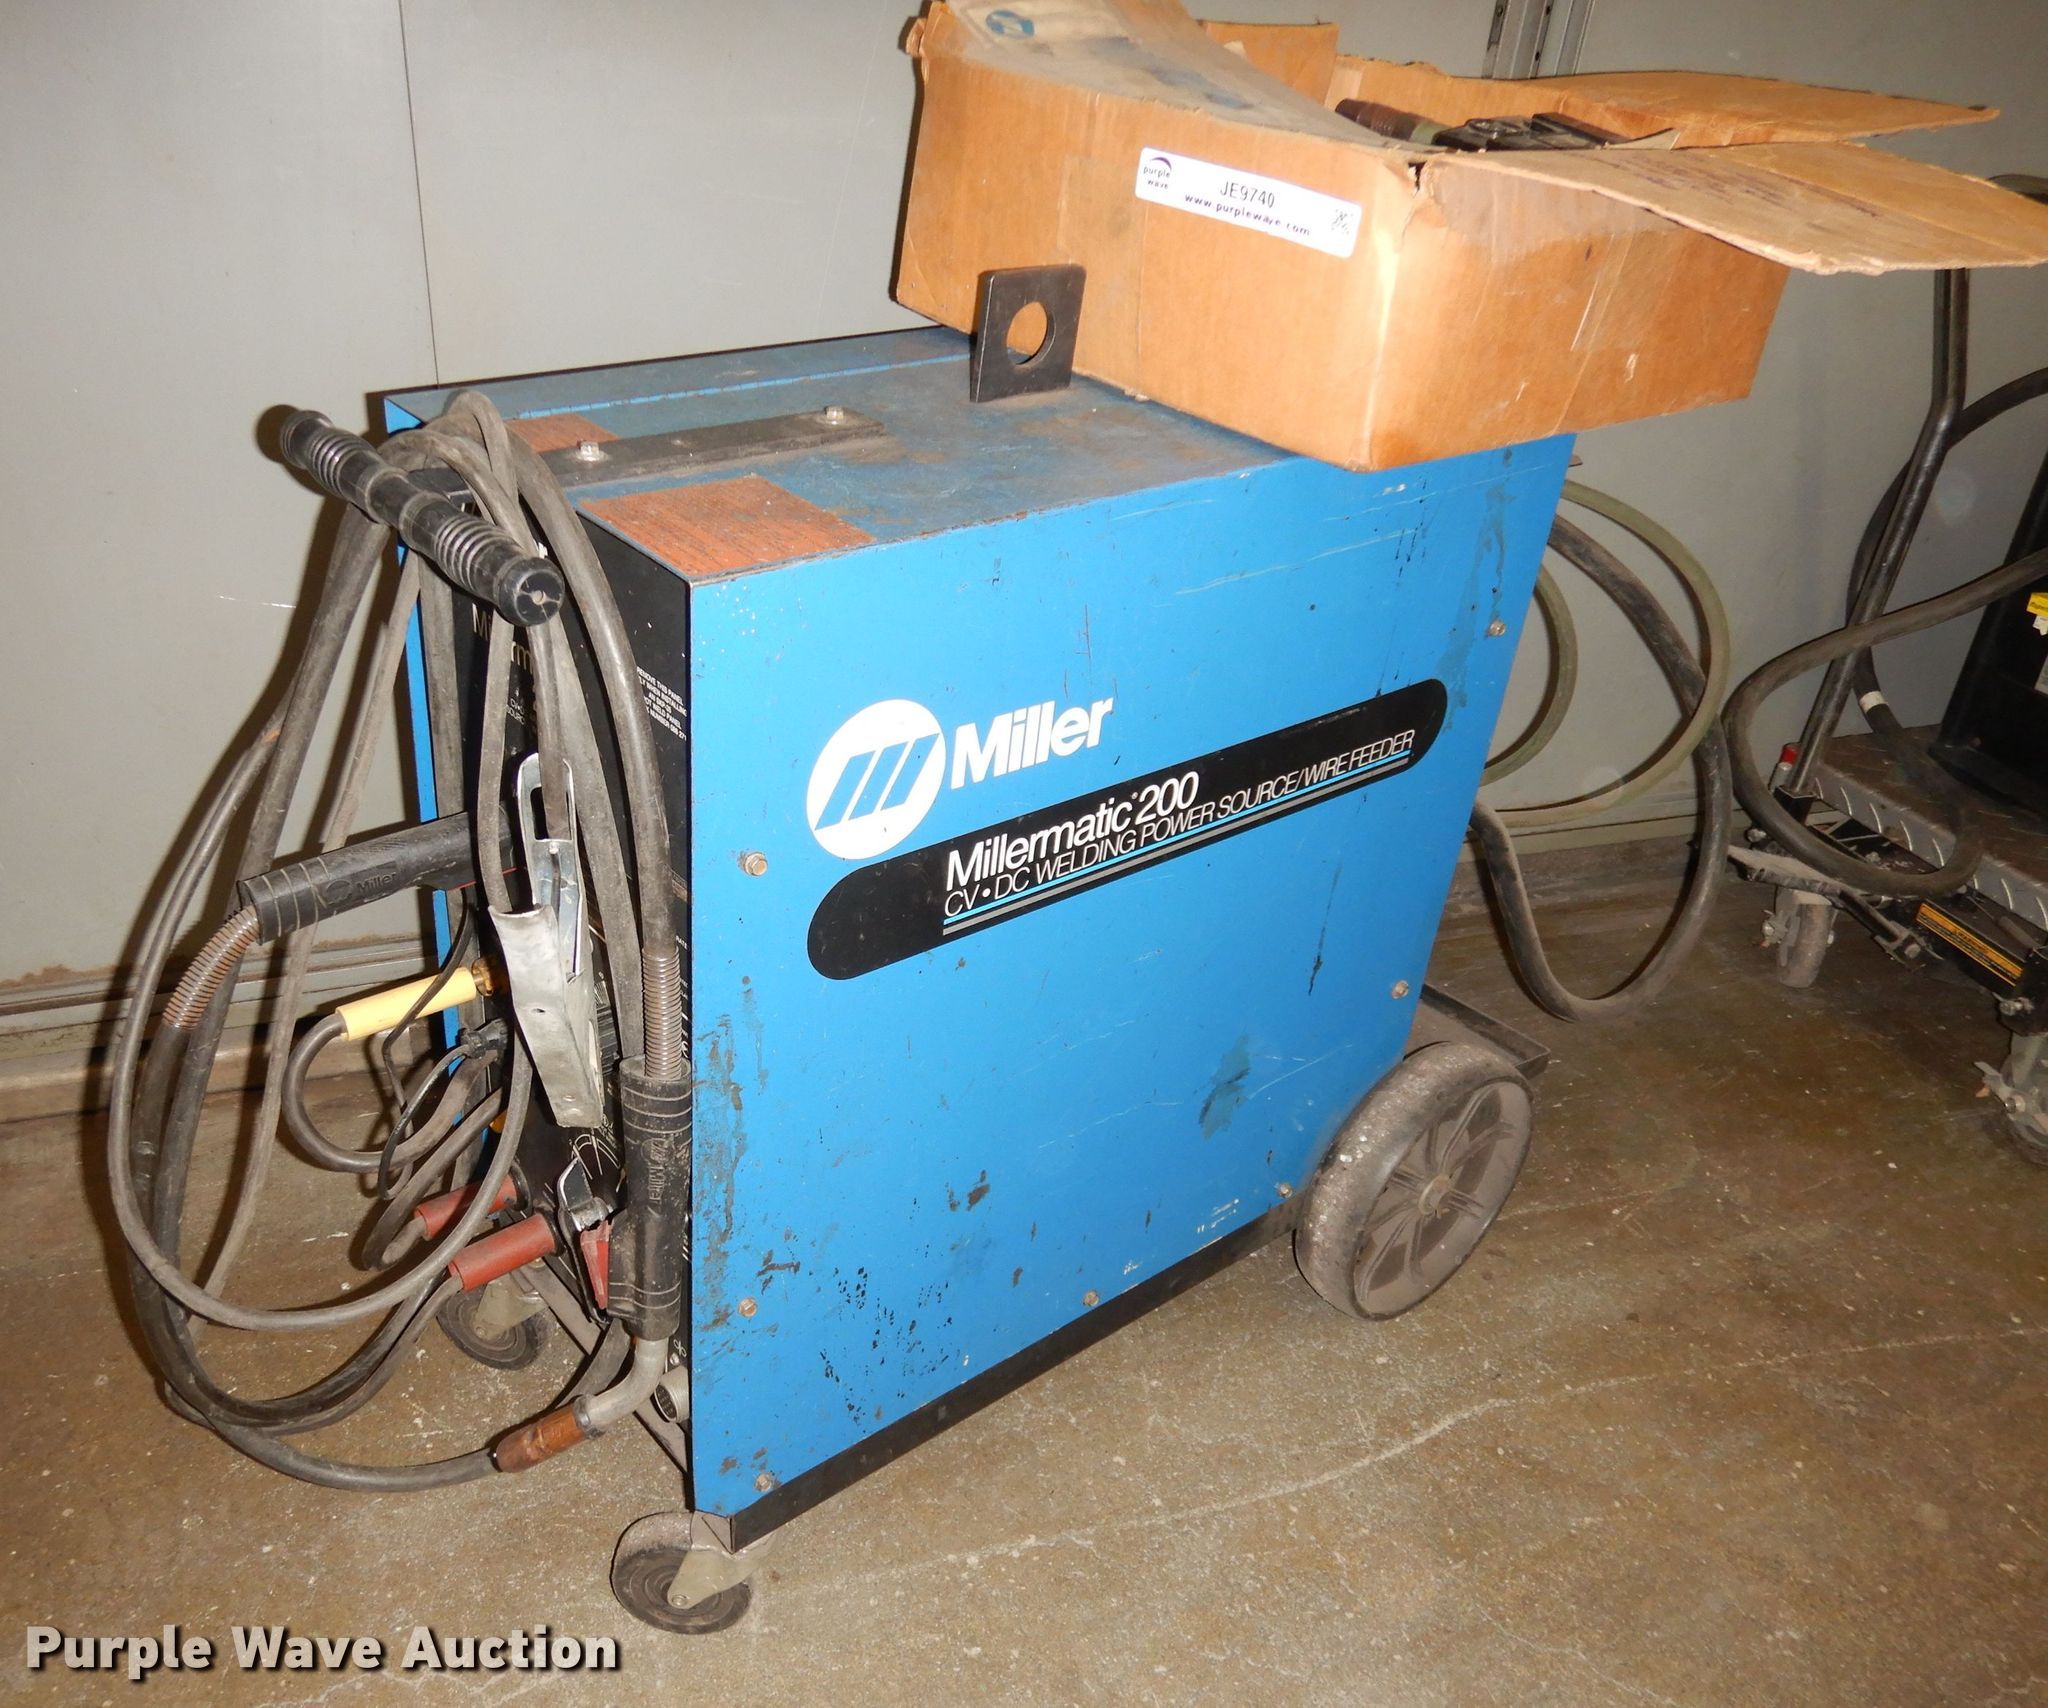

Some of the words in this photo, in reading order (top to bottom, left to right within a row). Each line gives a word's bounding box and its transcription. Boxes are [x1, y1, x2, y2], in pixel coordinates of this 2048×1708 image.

[1142, 165, 1172, 179] purple
[1147, 179, 1169, 190] wave
[1220, 180, 1276, 209] JE9740
[951, 697, 1114, 790] Miller
[1036, 830, 1137, 884] WELDING
[1140, 801, 1216, 848] POWER
[1349, 729, 1415, 770] FEEDER
[1135, 771, 1200, 826] 200
